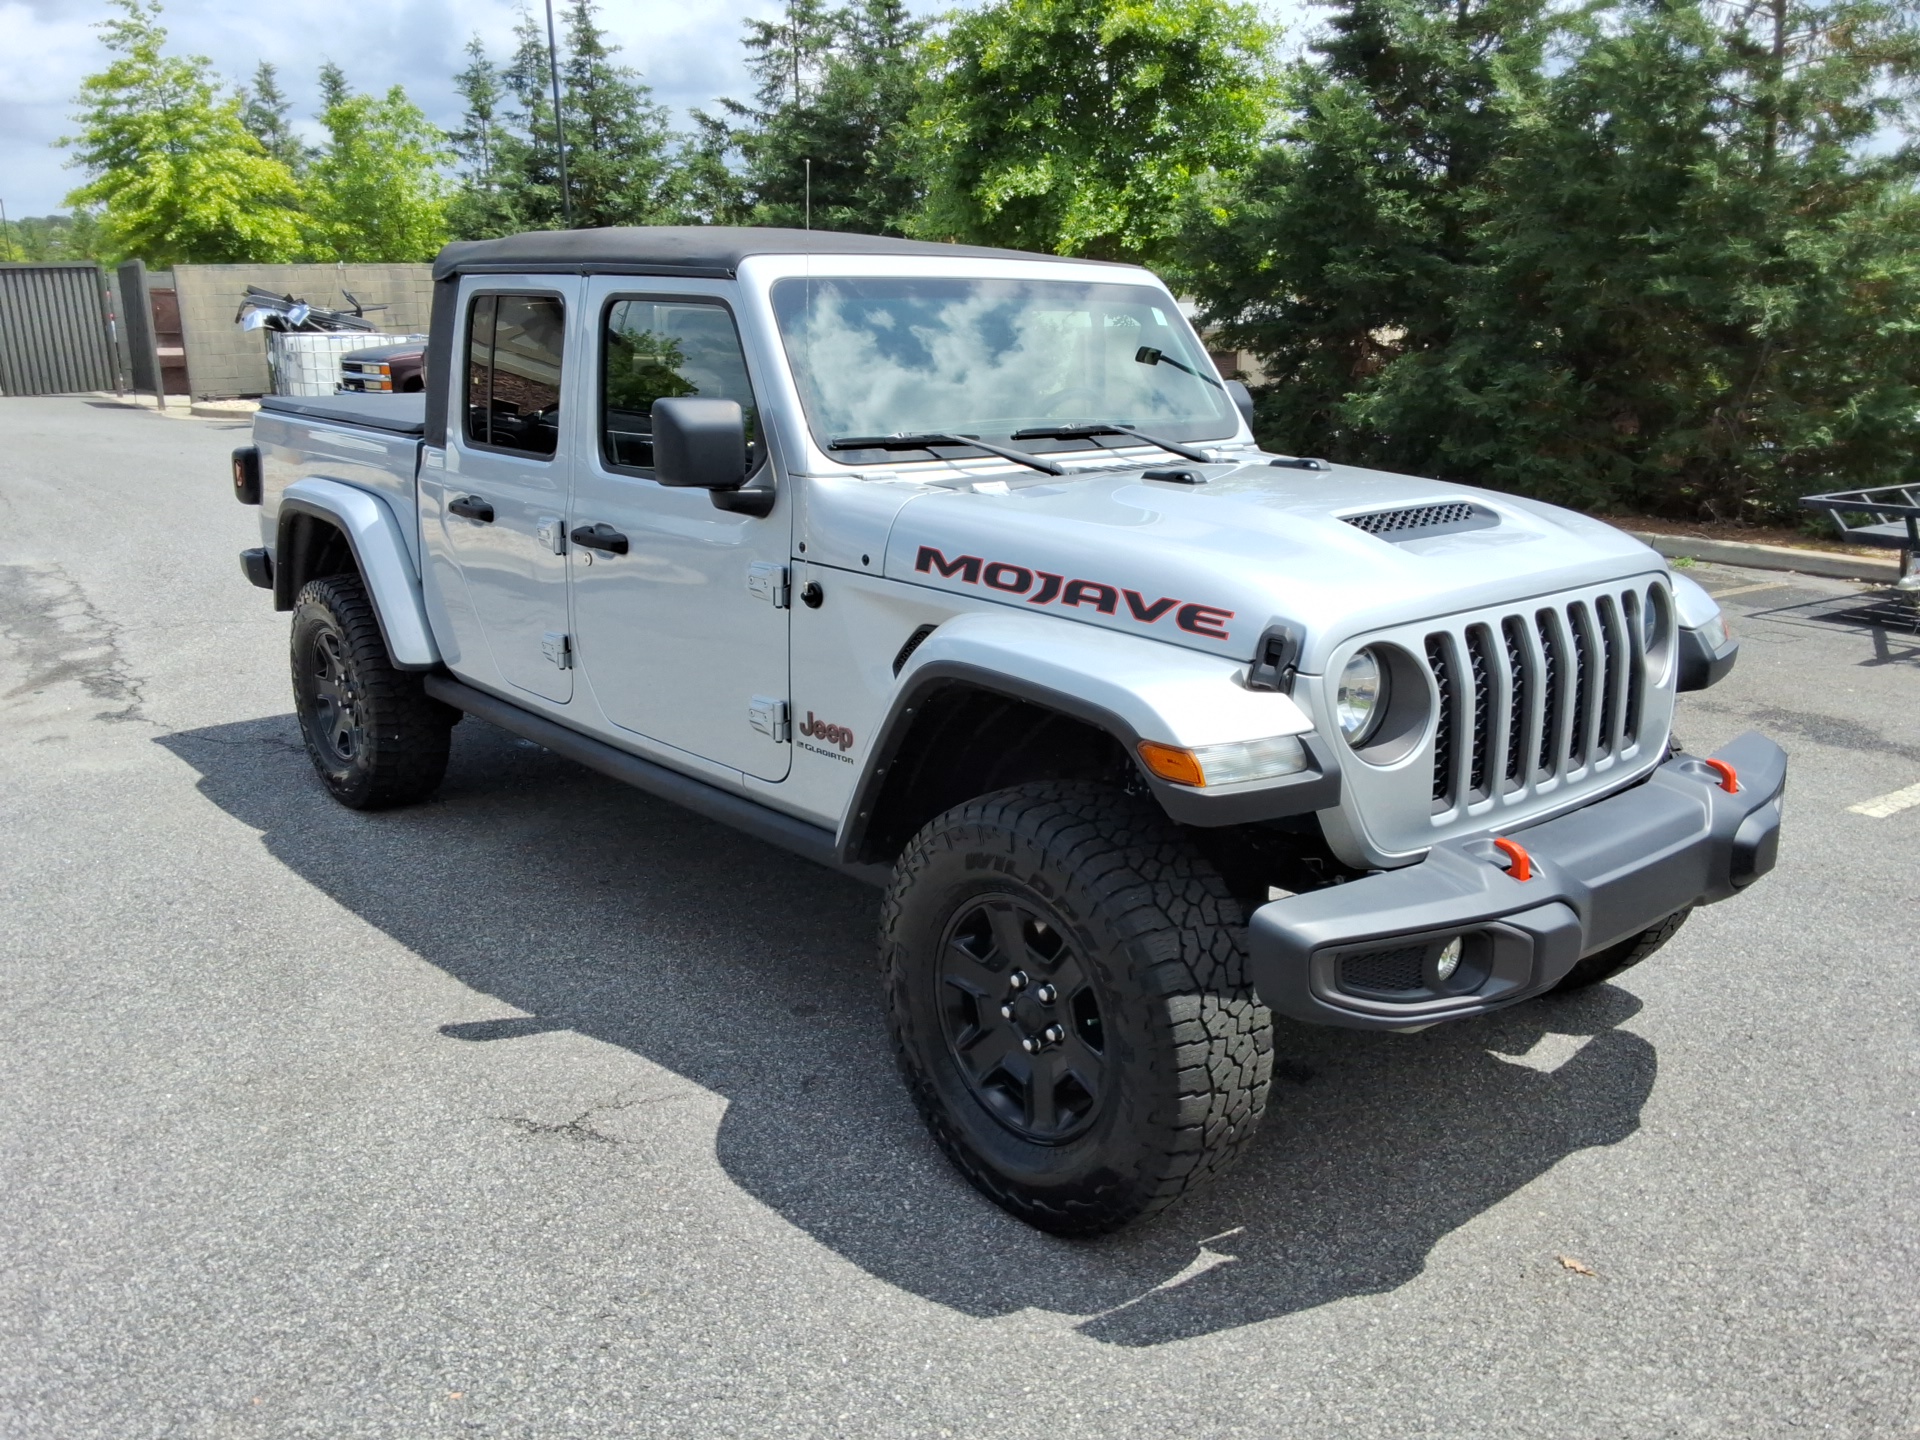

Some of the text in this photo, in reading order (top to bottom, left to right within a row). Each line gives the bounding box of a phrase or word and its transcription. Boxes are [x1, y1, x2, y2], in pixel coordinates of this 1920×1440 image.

[914, 545, 1235, 640] MOJAVE
[799, 710, 853, 752] Jeep
[804, 743, 854, 765] GLADIATOR
